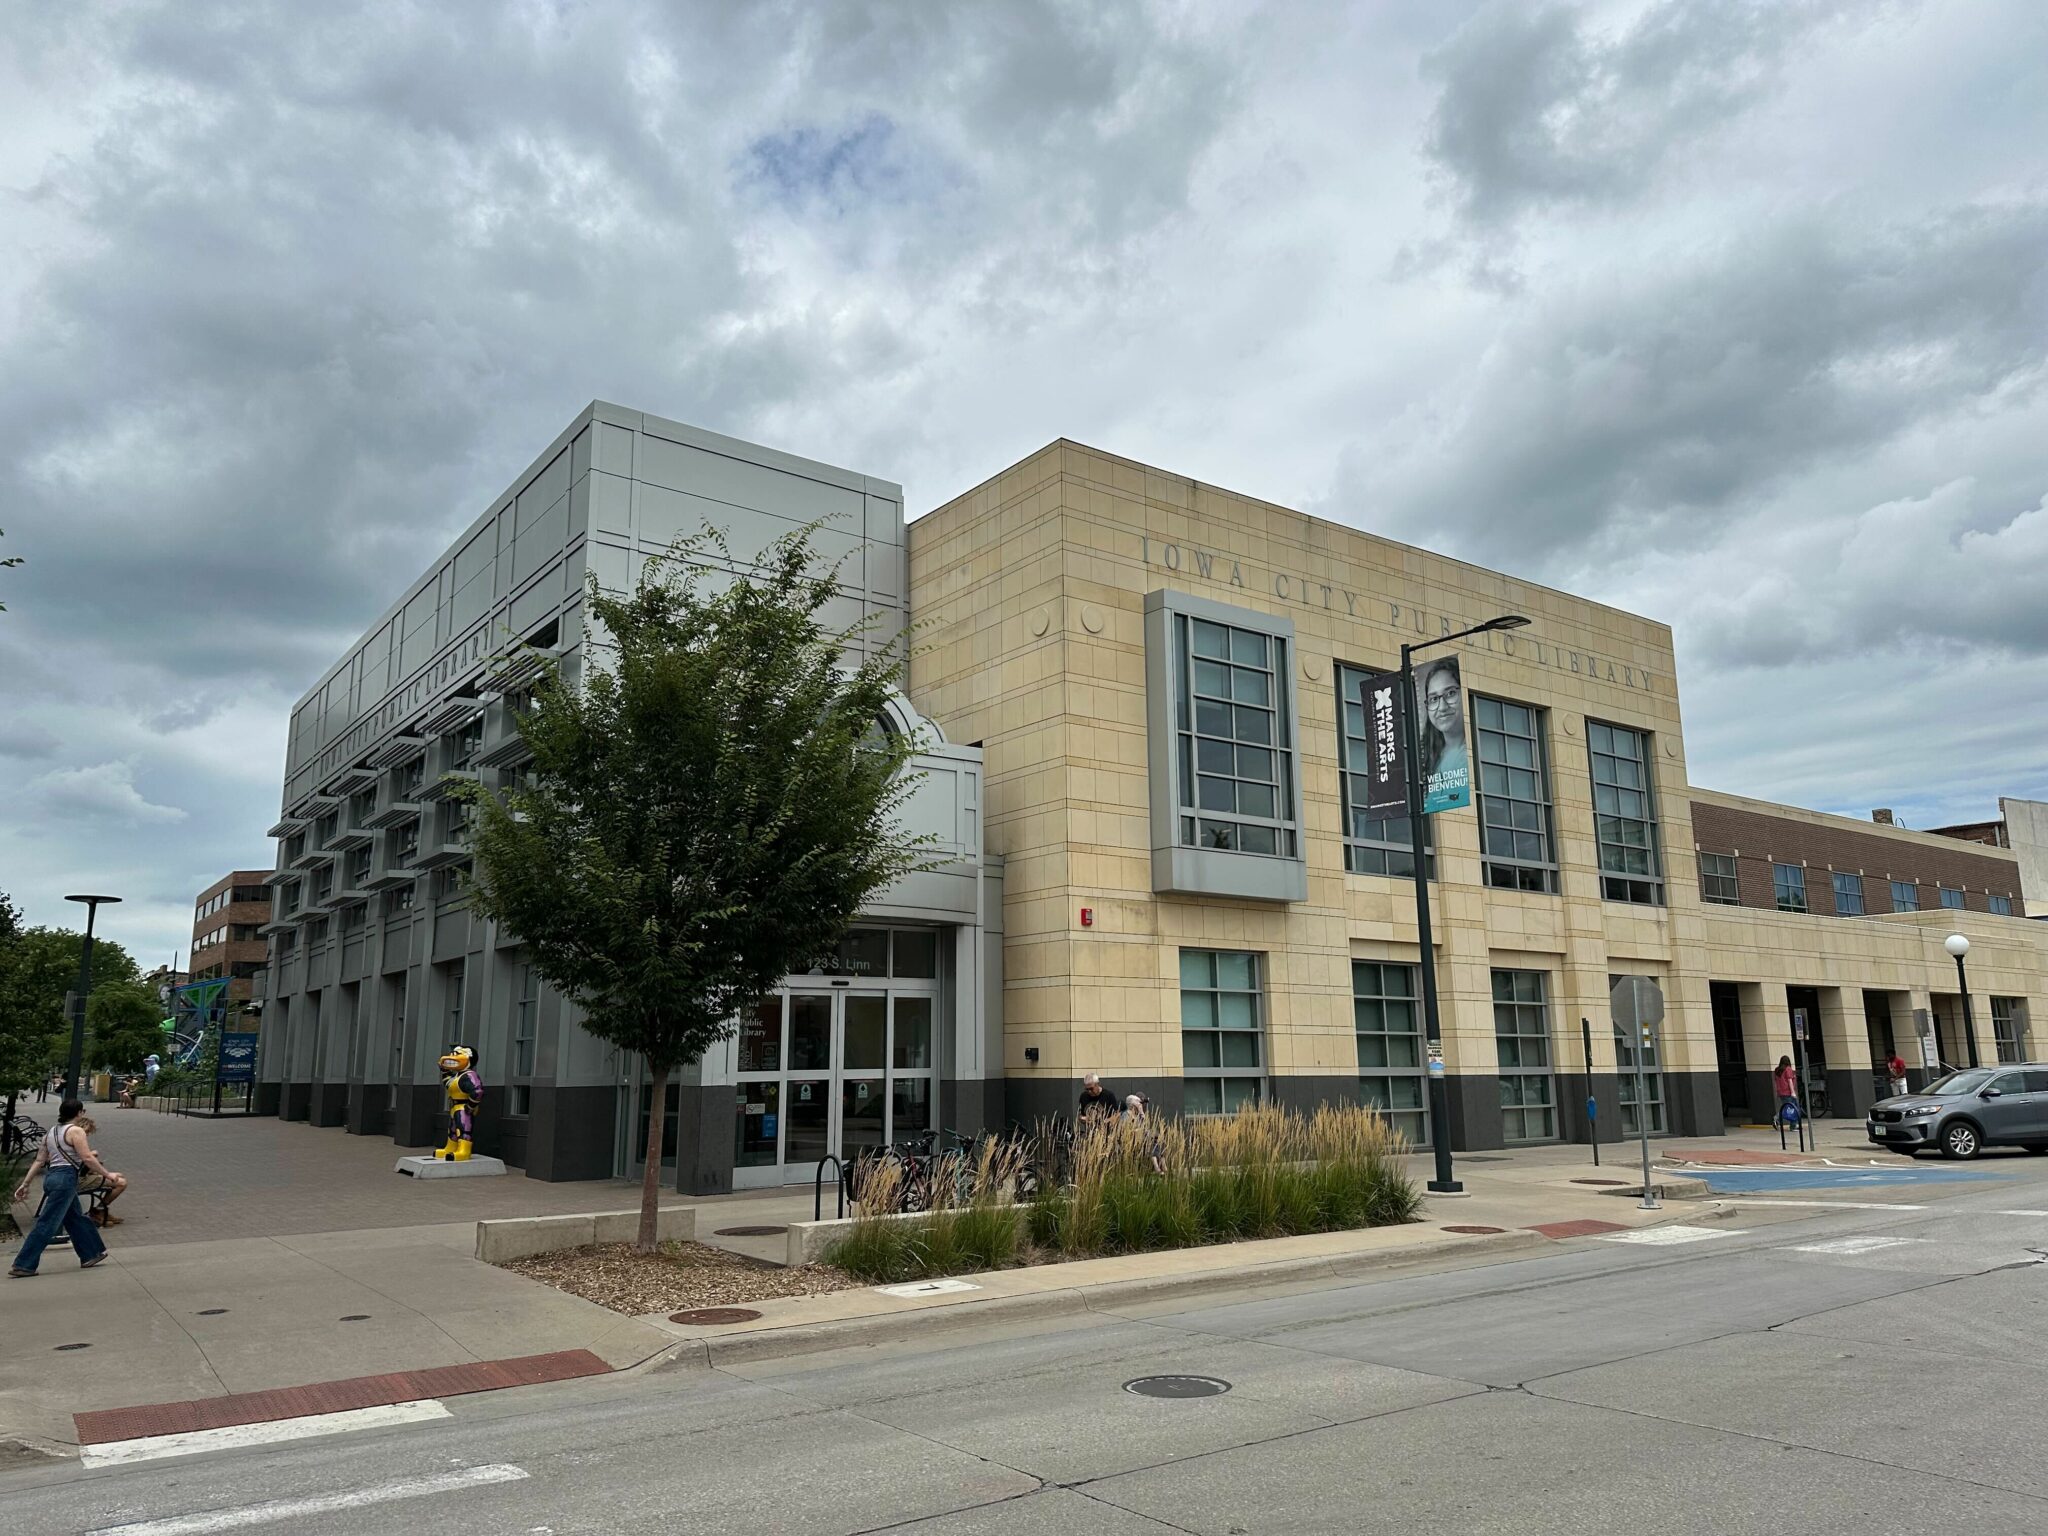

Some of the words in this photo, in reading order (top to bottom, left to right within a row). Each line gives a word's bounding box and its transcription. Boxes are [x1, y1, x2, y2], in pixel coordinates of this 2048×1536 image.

[1141, 536, 1244, 588] IOWA
[1275, 574, 1358, 616] CITY
[1389, 603, 1516, 656] PUBLIC
[1533, 641, 1651, 691] LIBRARY
[320, 743, 342, 778] IOWA
[346, 722, 370, 757] CITY
[373, 681, 421, 736] PUBLIC
[426, 627, 489, 694] LIBRARY
[1376, 709, 1386, 741] THE
[1385, 707, 1395, 762] MARKS
[1379, 744, 1388, 782] ARTS
[1427, 767, 1467, 784] WELCOME!
[807, 958, 829, 969] 123
[846, 958, 870, 970] Linn
[740, 1017, 764, 1028] Public
[740, 1028, 767, 1039] Library
